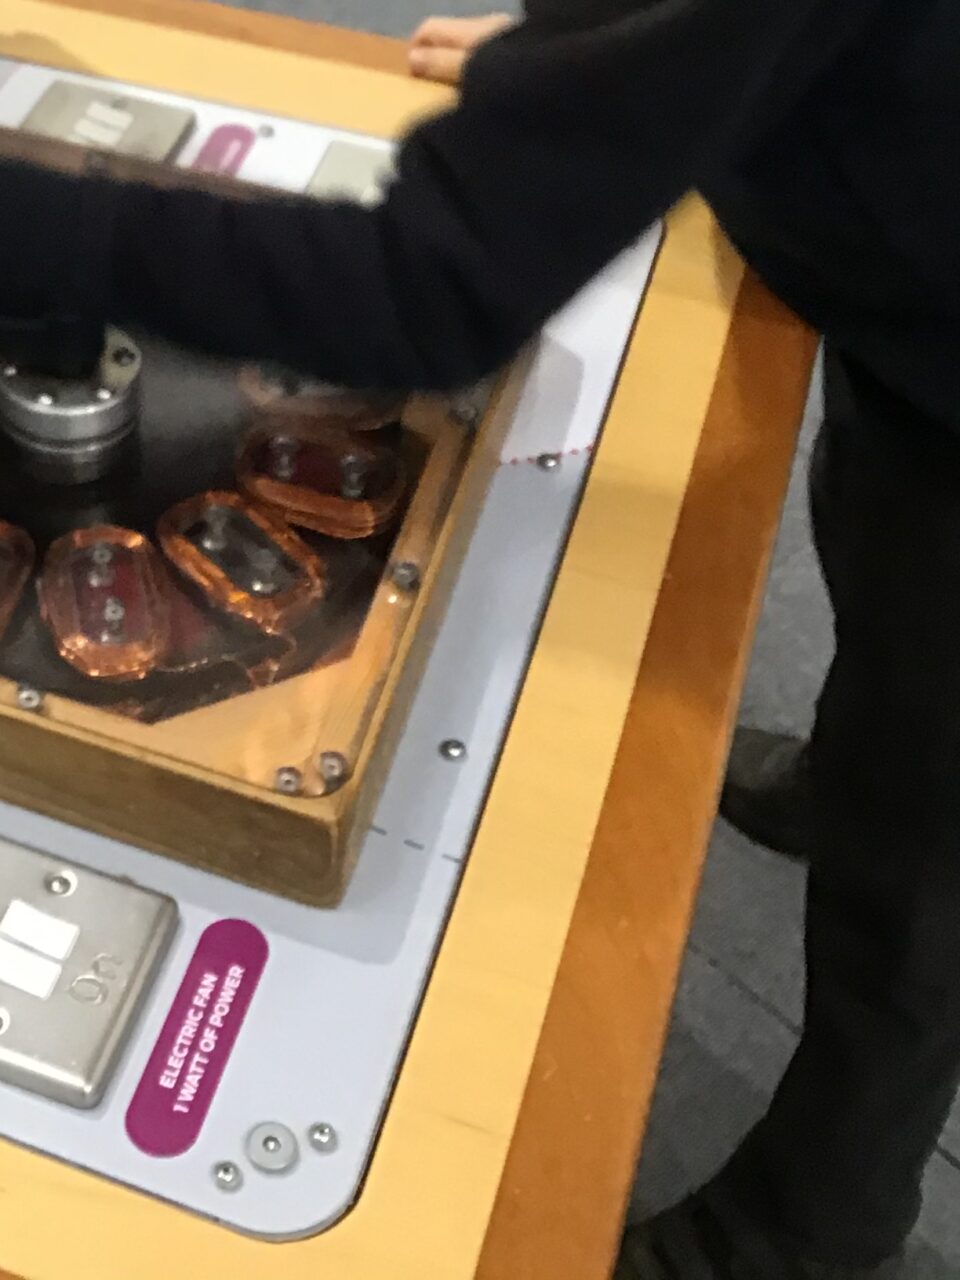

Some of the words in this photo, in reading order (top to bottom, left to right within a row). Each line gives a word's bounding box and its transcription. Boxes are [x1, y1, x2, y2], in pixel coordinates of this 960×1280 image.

[208, 962, 246, 1028] POWER
[158, 1008, 204, 1089] ELECTRIC
[194, 970, 219, 1009] FAN
[198, 1026, 220, 1054] OF
[177, 1051, 210, 1105] WATT
